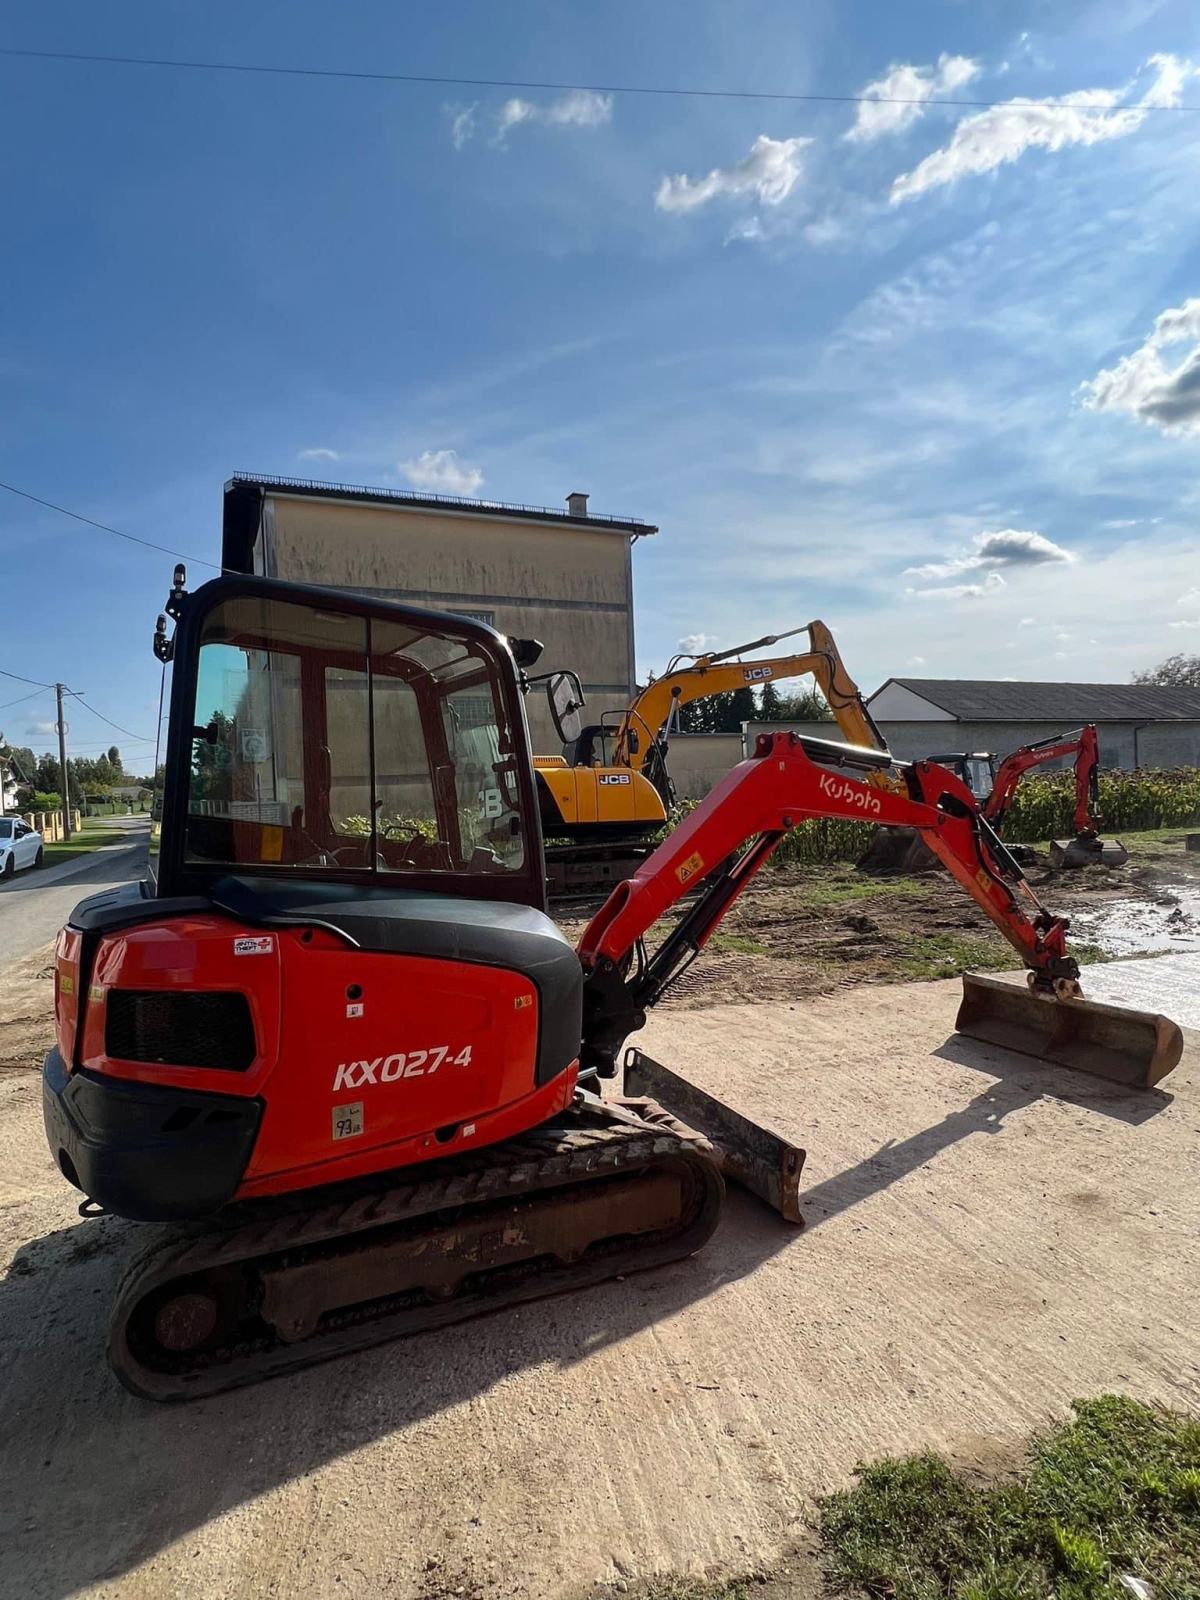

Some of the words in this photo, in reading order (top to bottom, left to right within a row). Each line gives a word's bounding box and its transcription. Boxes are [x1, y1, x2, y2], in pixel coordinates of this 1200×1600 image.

[744, 667, 773, 681] JCB
[600, 775, 630, 785] JCB
[820, 774, 881, 814] Kubota
[332, 1045, 473, 1092] KX027-4
[336, 1118, 352, 1137] 93
